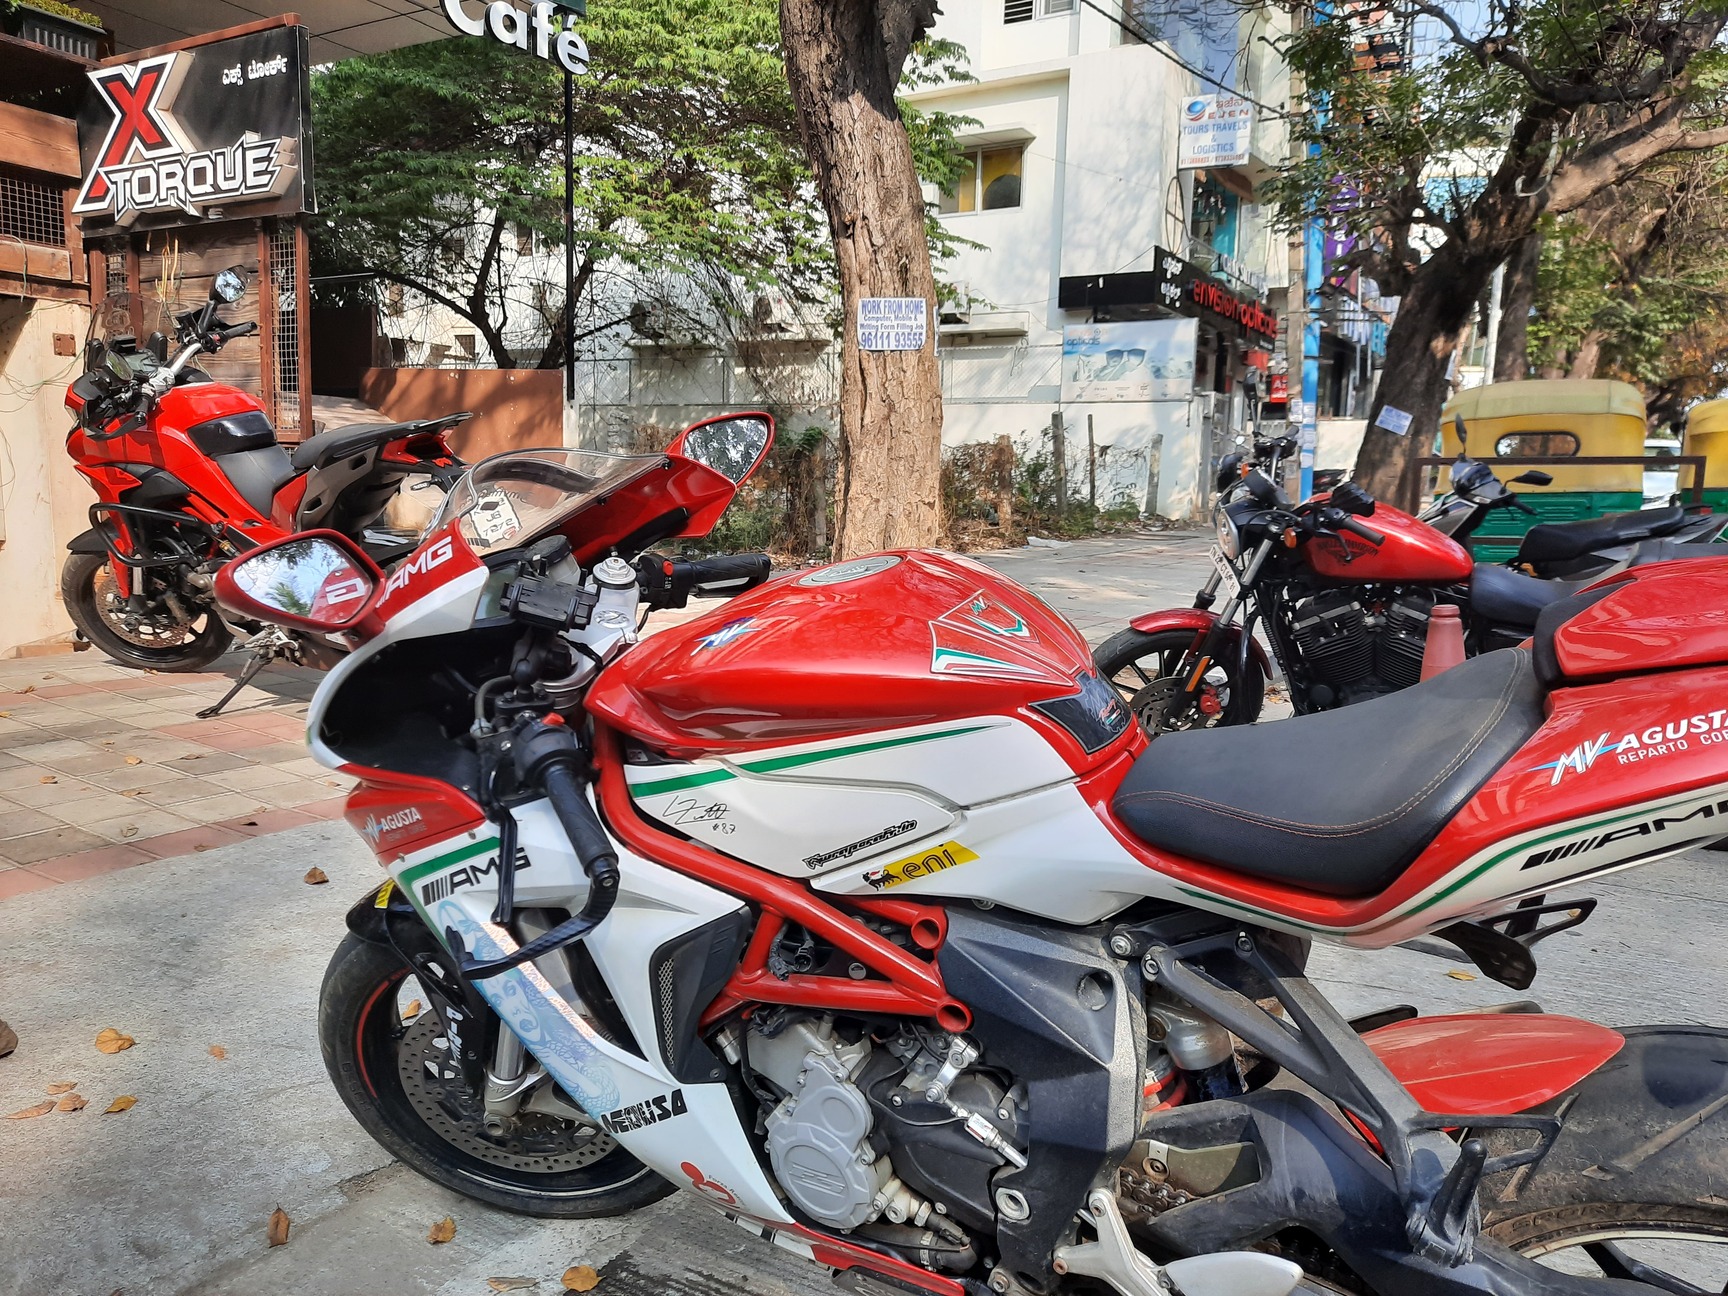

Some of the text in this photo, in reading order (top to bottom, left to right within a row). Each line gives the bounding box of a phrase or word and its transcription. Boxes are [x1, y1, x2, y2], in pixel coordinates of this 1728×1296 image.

[75, 53, 180, 211] X
[1183, 121, 1248, 135] TOURS TRAVELS
[1192, 143, 1234, 154] LOGISTICS
[100, 141, 281, 217] TORQUE
[861, 300, 923, 314] WORK FROM HOME
[861, 332, 923, 348] 96111 93555
[385, 535, 453, 601] AMG
[1618, 739, 1689, 765] REPARTO
[381, 807, 422, 833] AGUSTA
[902, 844, 957, 879] eni
